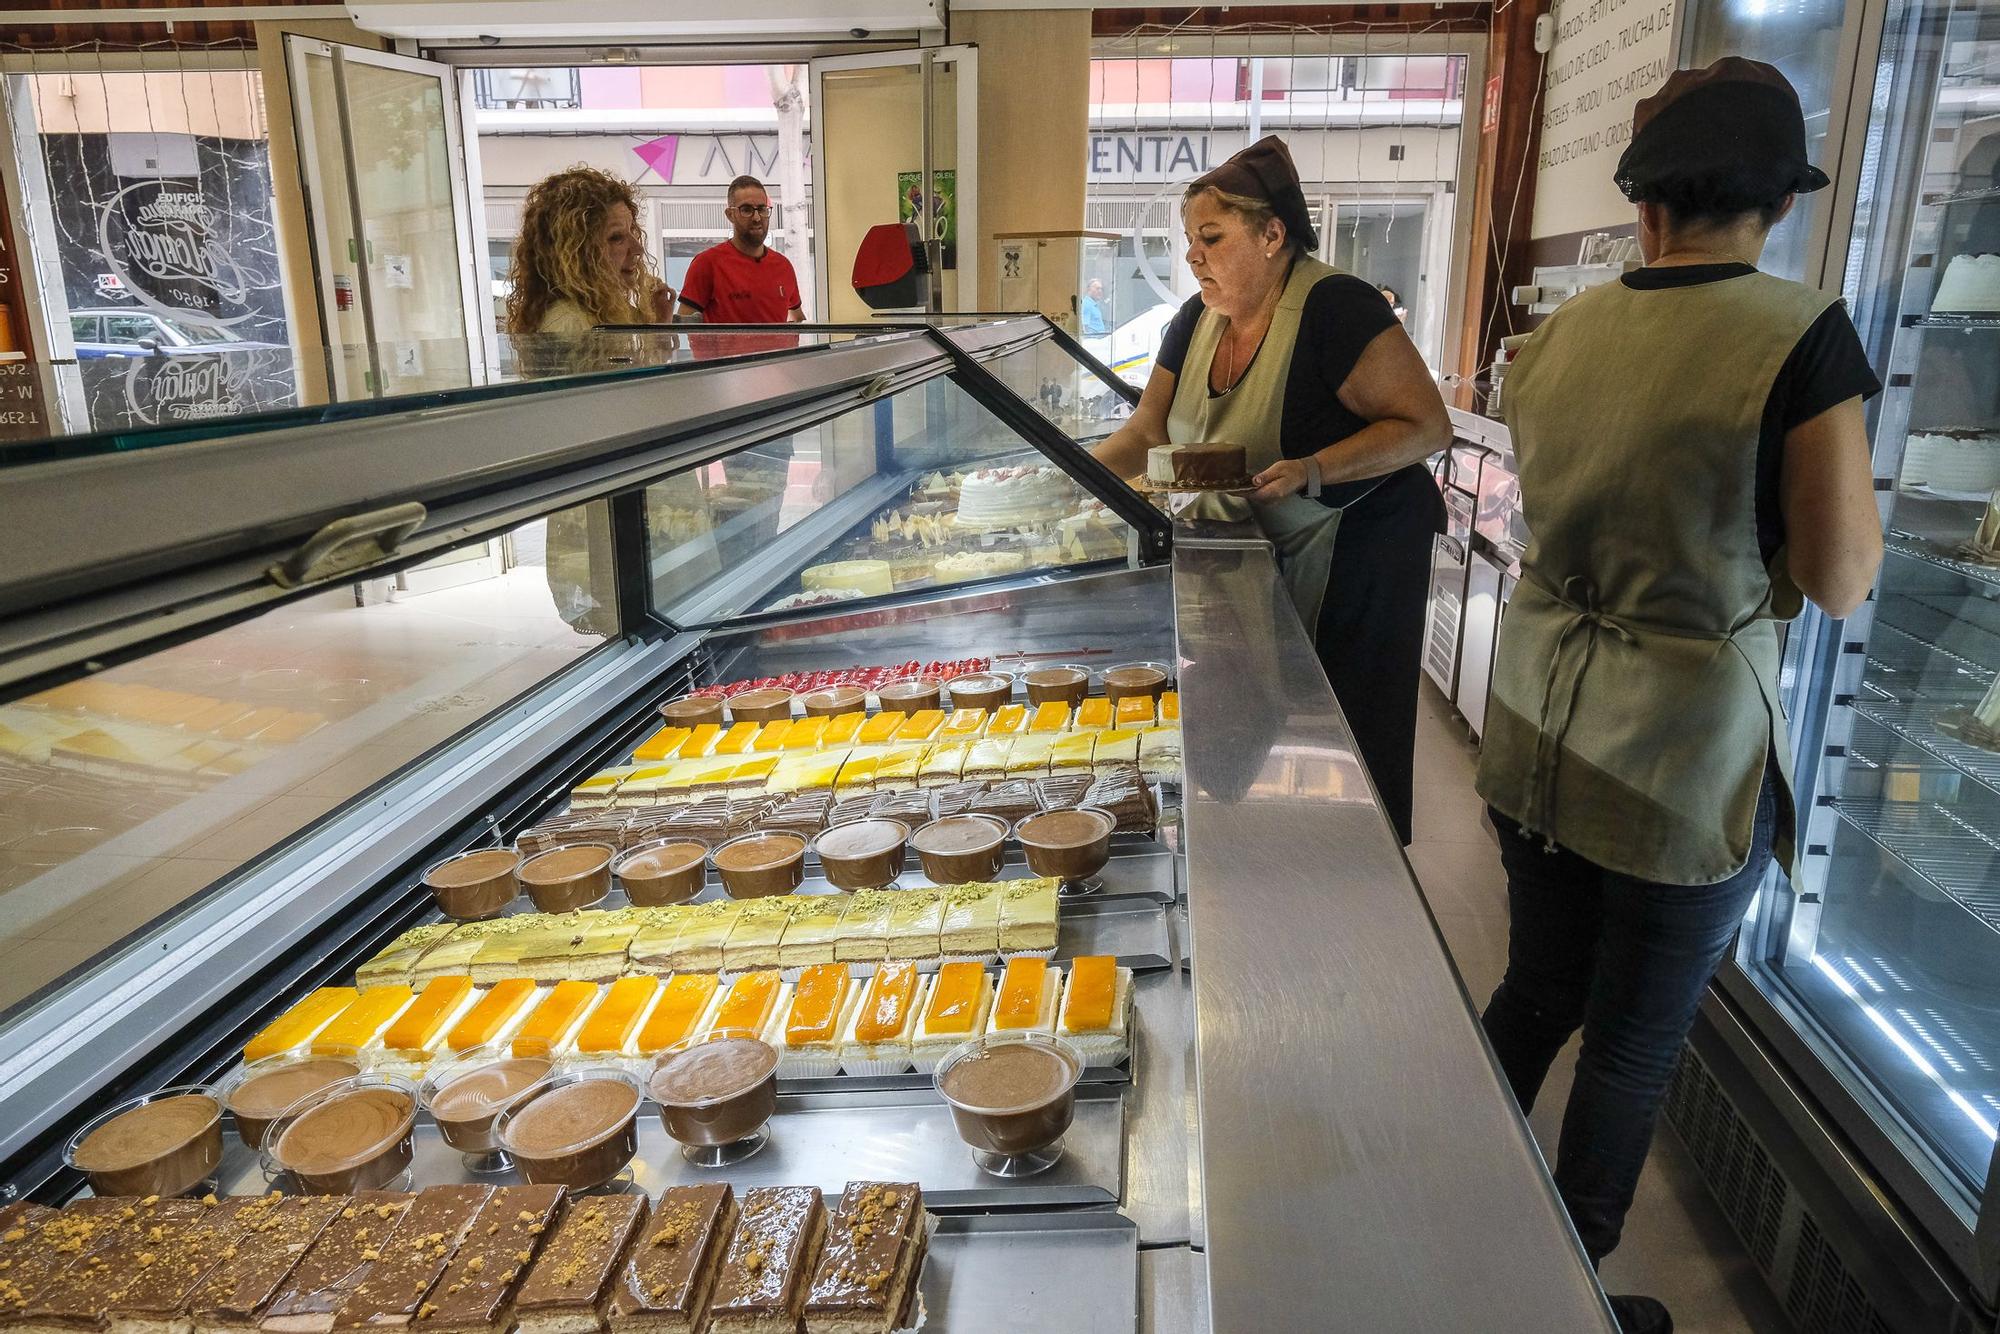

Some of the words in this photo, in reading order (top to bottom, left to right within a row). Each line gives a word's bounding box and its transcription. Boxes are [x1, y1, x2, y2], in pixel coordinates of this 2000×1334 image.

[1618, 13, 1655, 52] TRUCHA
[1657, 2, 1672, 32] DE
[1623, 56, 1668, 96] ARTESAN
[1087, 135, 1216, 173] ENTAL
